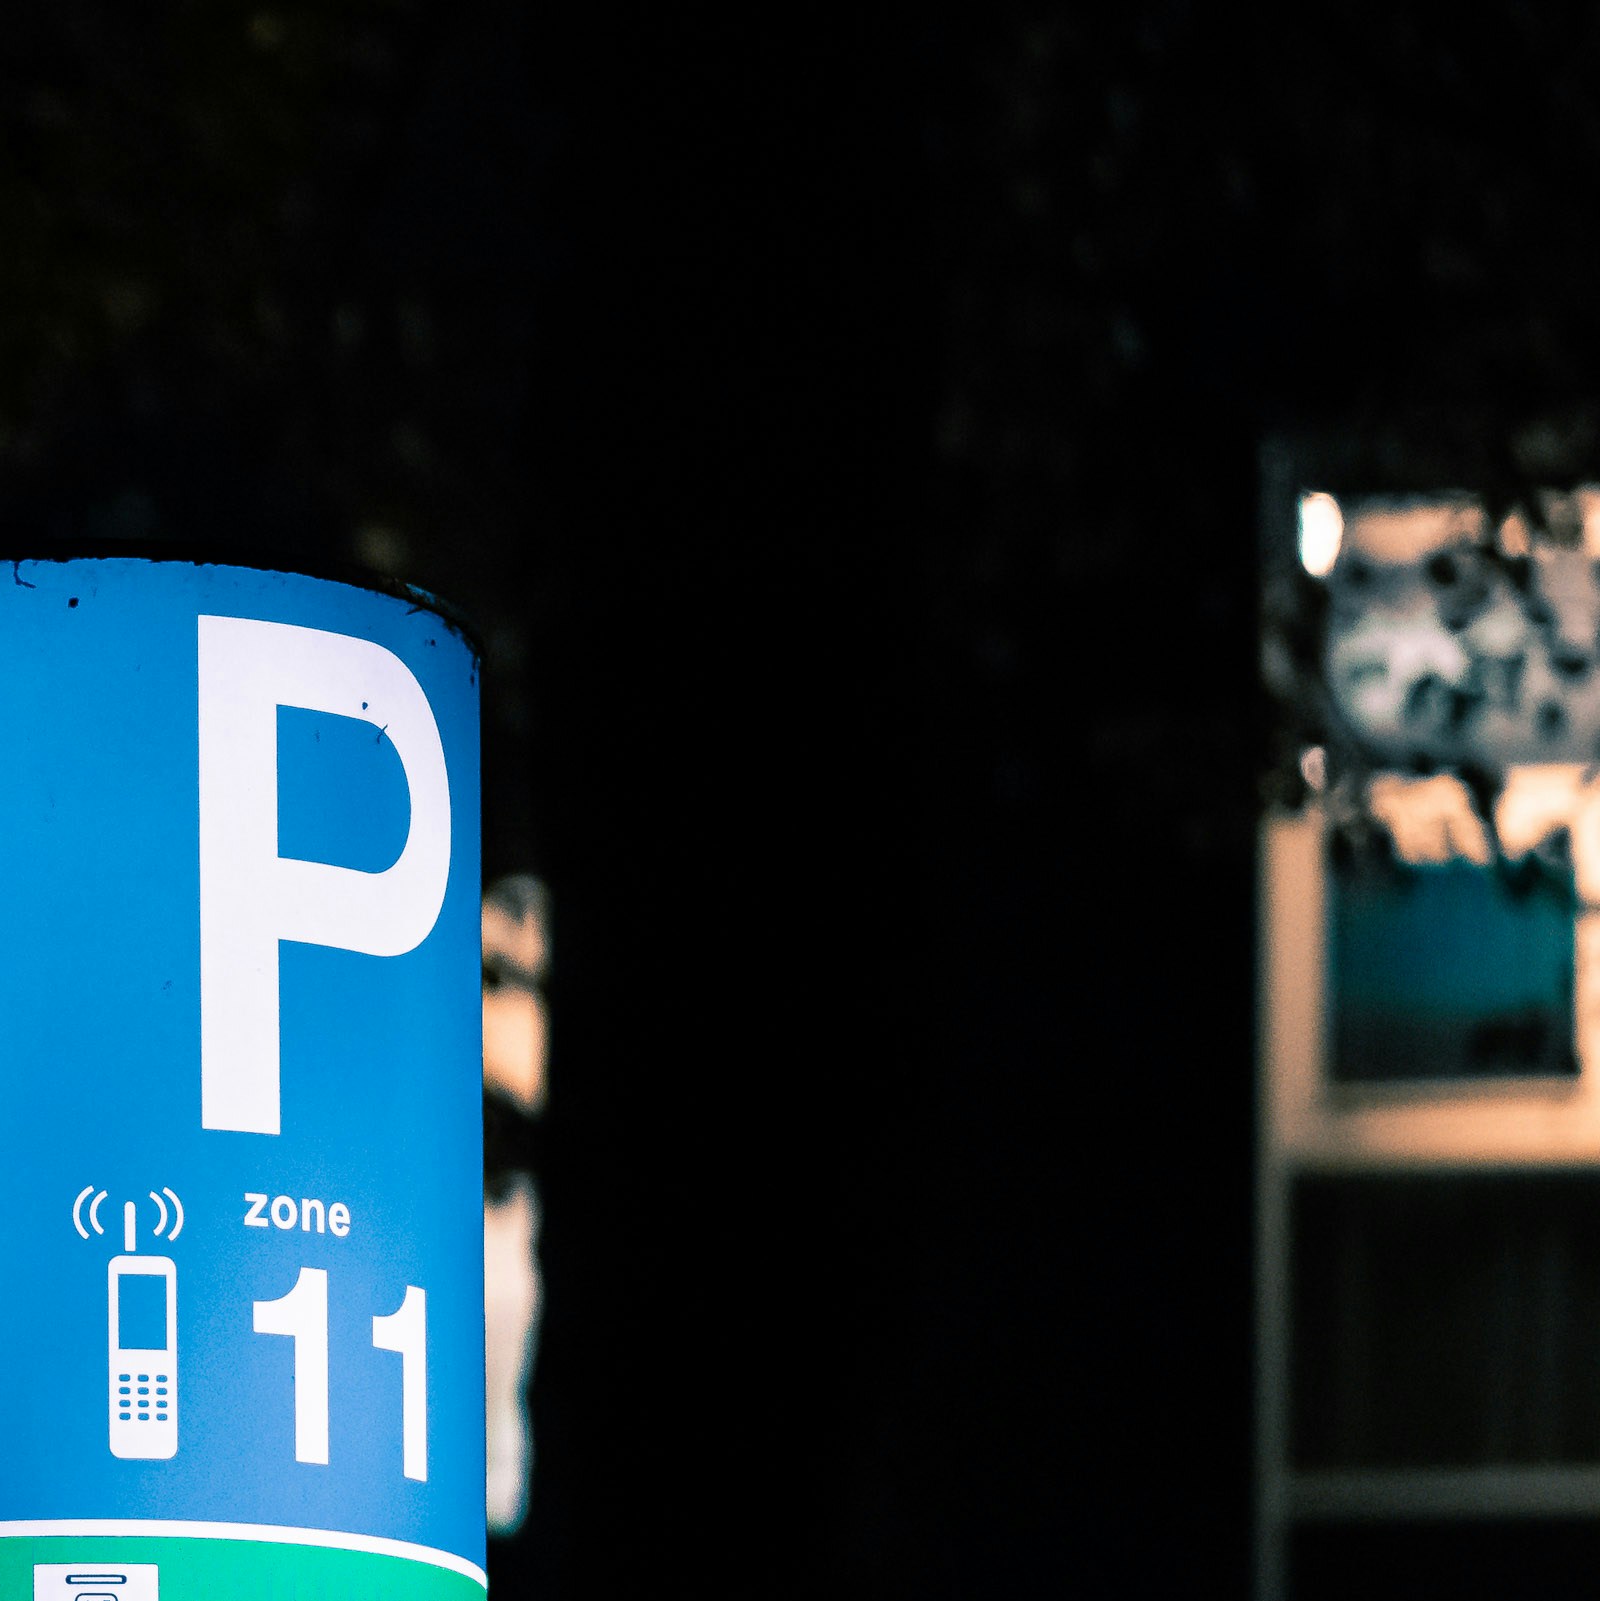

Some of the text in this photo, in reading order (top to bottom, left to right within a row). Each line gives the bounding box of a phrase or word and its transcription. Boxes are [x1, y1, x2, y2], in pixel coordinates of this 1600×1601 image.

[196, 613, 453, 1136] P
[243, 1192, 351, 1237] zone
[252, 1266, 428, 1482] 11
